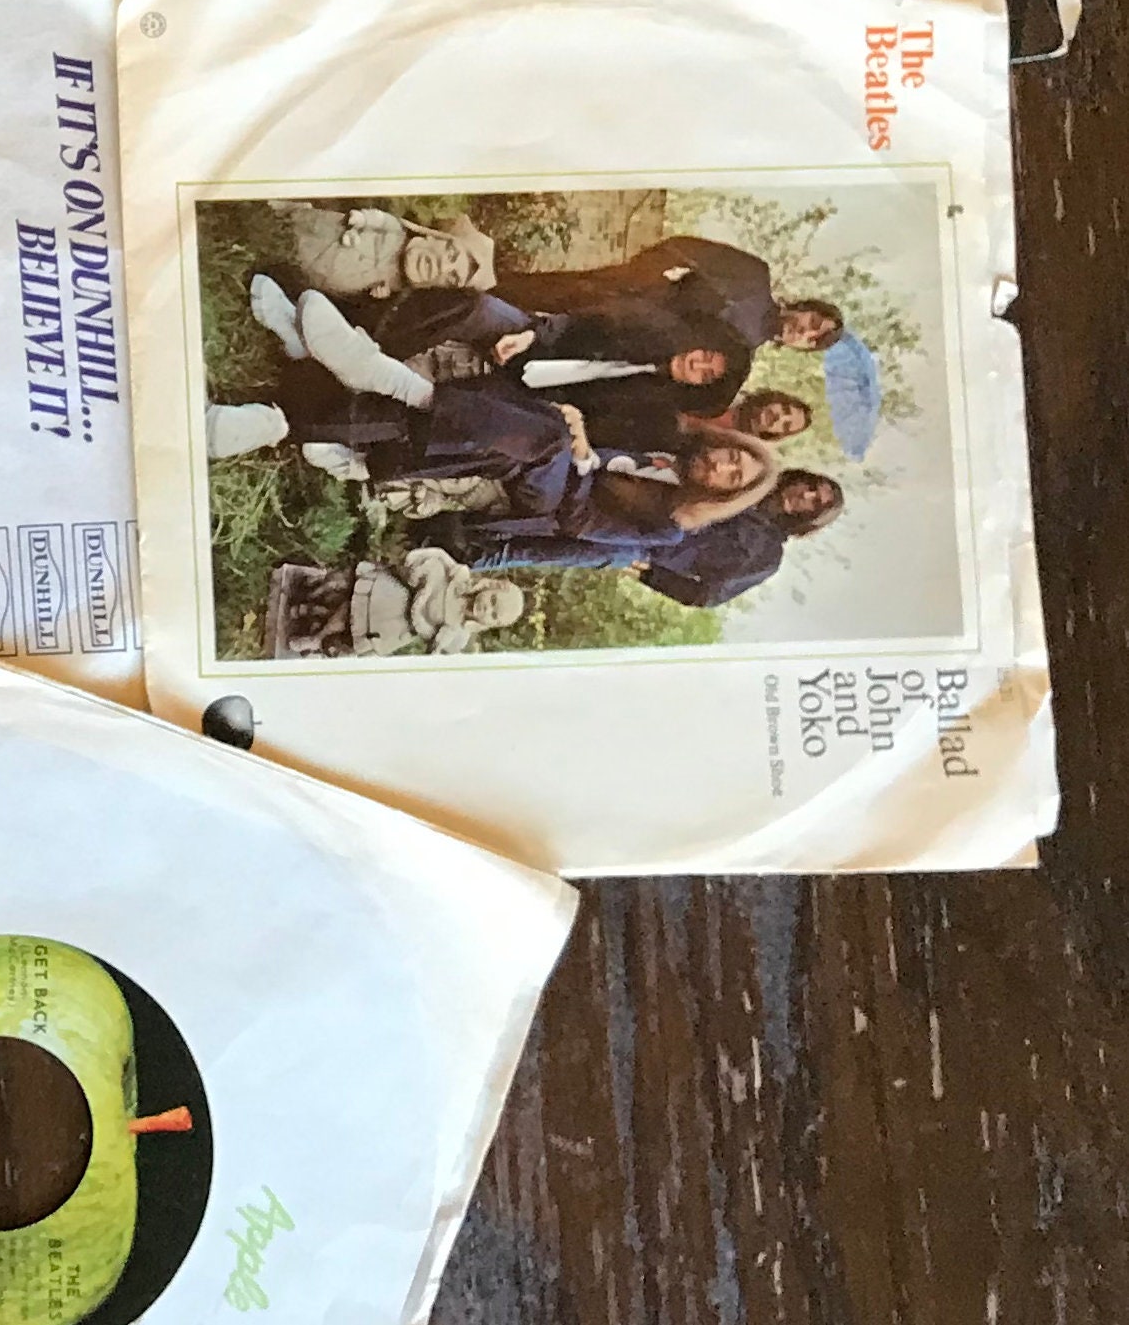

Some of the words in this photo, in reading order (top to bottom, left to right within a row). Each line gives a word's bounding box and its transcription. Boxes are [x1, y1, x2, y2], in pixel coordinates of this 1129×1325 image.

[53, 52, 94, 92] IF
[865, 24, 899, 151] Beatles
[901, 21, 934, 89] The
[55, 94, 102, 172] IT'S
[62, 179, 108, 240] ON
[15, 219, 67, 377] BELIEVE
[28, 381, 72, 440] IT!
[32, 536, 54, 646] DUNHILL
[86, 534, 109, 644] DUNHILL
[764, 674, 780, 702] Old
[798, 668, 833, 758] Yoko
[833, 671, 869, 737] and
[865, 667, 901, 753] John
[901, 669, 935, 709] of
[765, 707, 782, 756] Brown
[936, 668, 980, 778] Ballad
[769, 759, 785, 797] Shoe
[33, 945, 48, 980] GET
[33, 988, 48, 1035] BACK
[48, 1238, 62, 1321] BEATLES
[66, 1264, 81, 1299] THE
[223, 1185, 296, 1312] Apple
